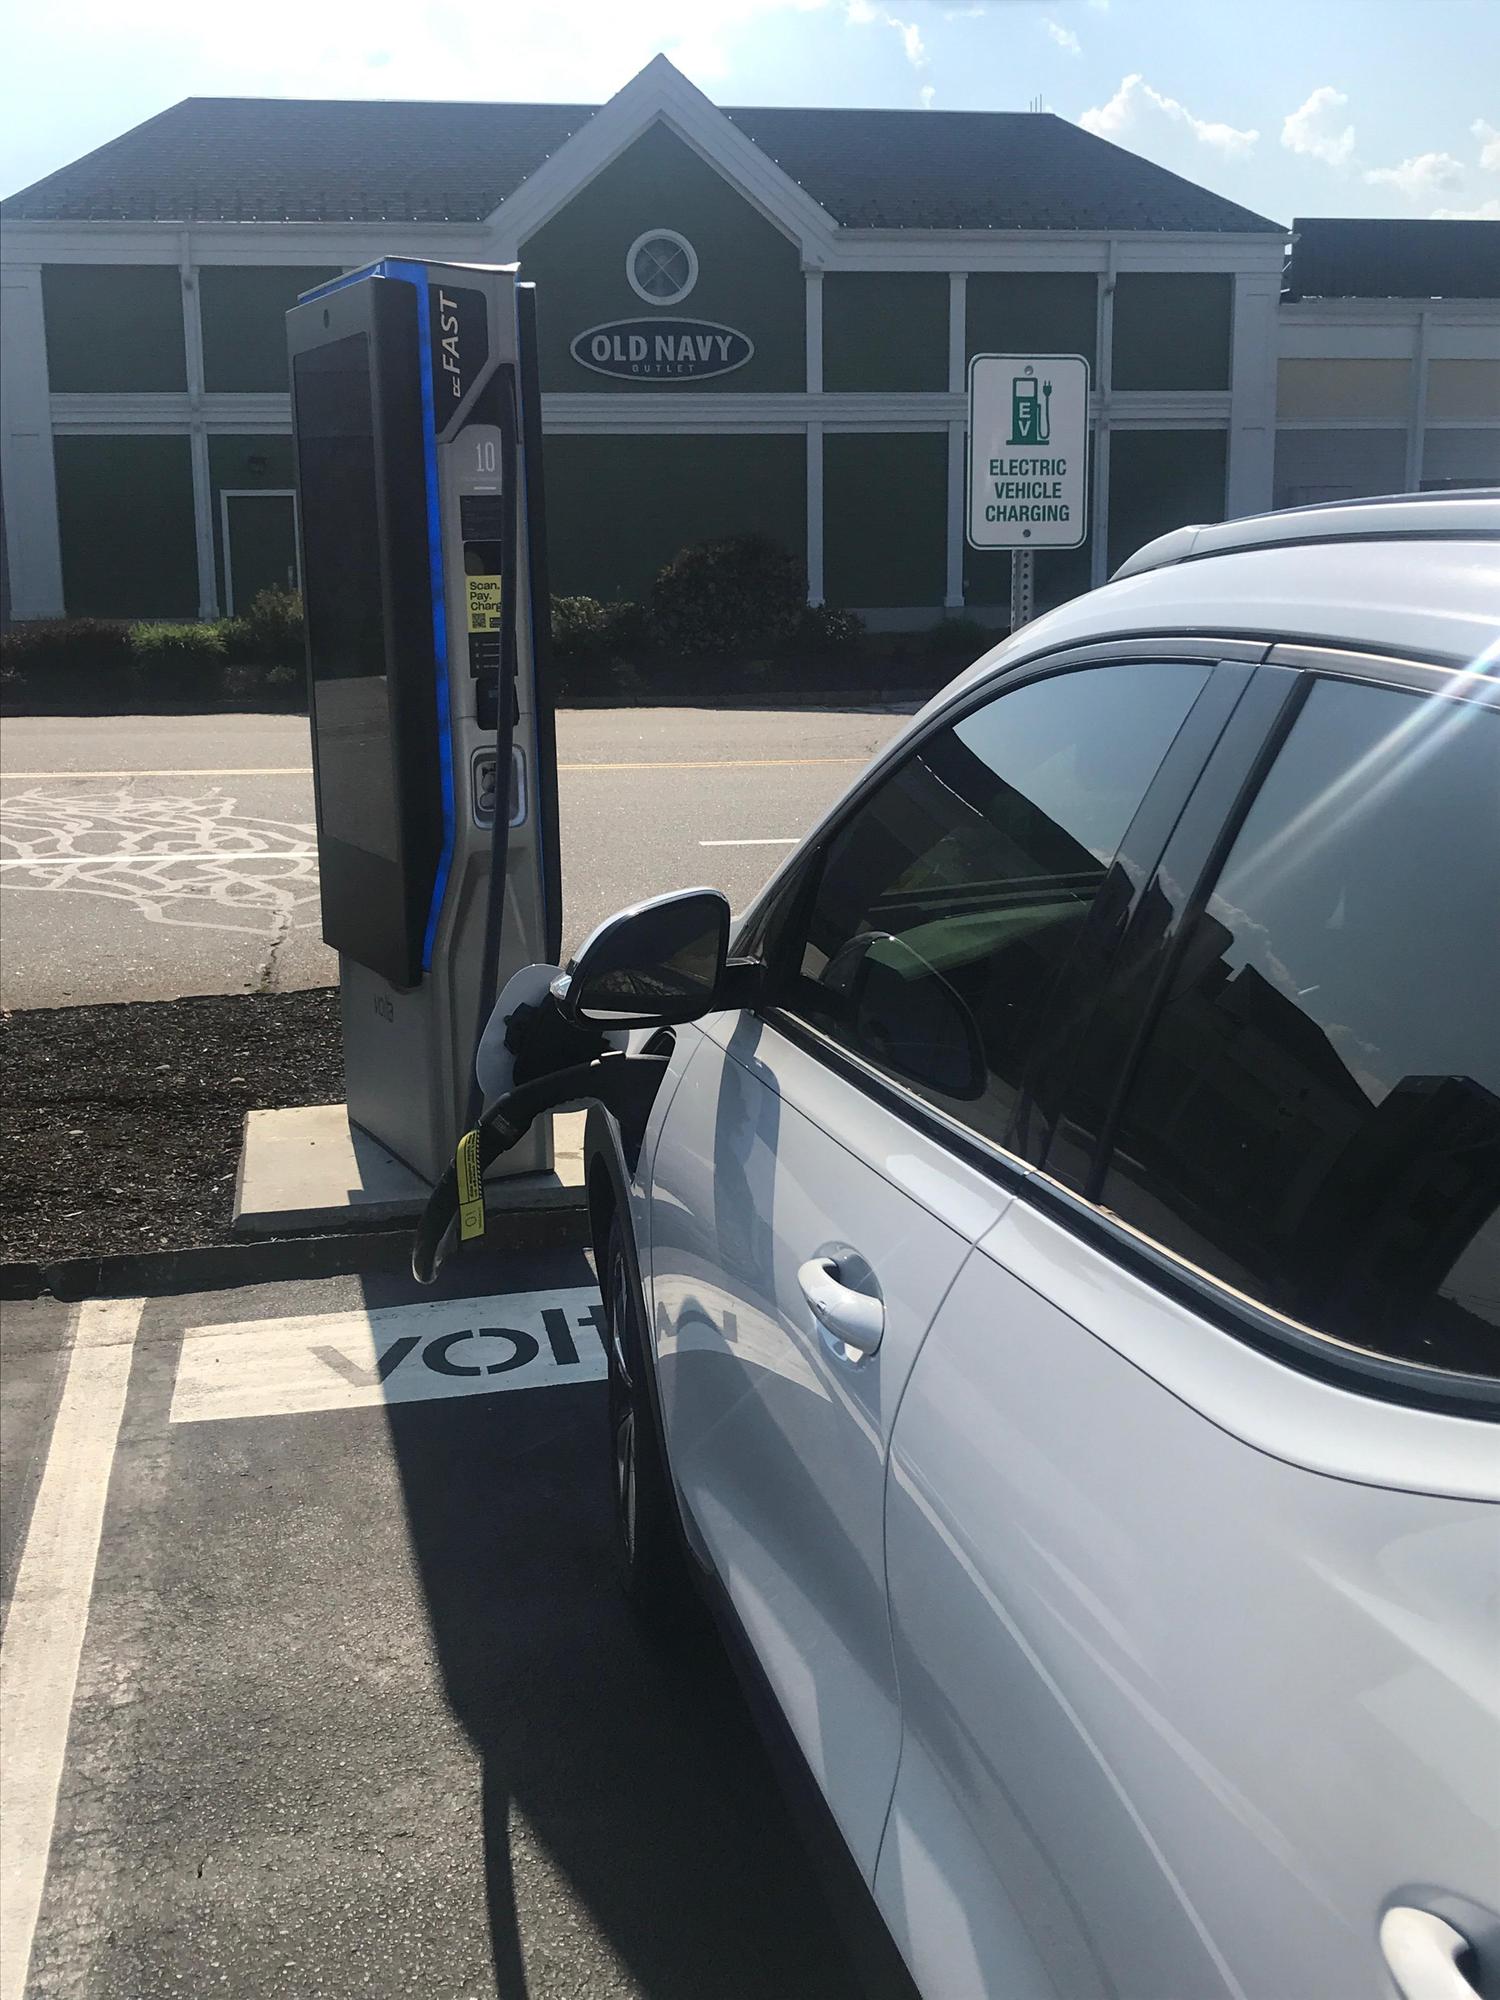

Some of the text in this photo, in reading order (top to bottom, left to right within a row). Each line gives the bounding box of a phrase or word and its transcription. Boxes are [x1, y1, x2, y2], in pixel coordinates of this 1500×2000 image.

[440, 289, 461, 375] FAST
[591, 335, 733, 362] OLD NAVY
[631, 364, 695, 373] OUTLET
[475, 441, 496, 473] 10
[989, 459, 1067, 476] ELECTRIC
[994, 482, 1062, 499] VEHICLE
[985, 505, 1070, 522] CHARGING
[469, 581, 501, 591] Scan.
[469, 591, 493, 602] Pay.
